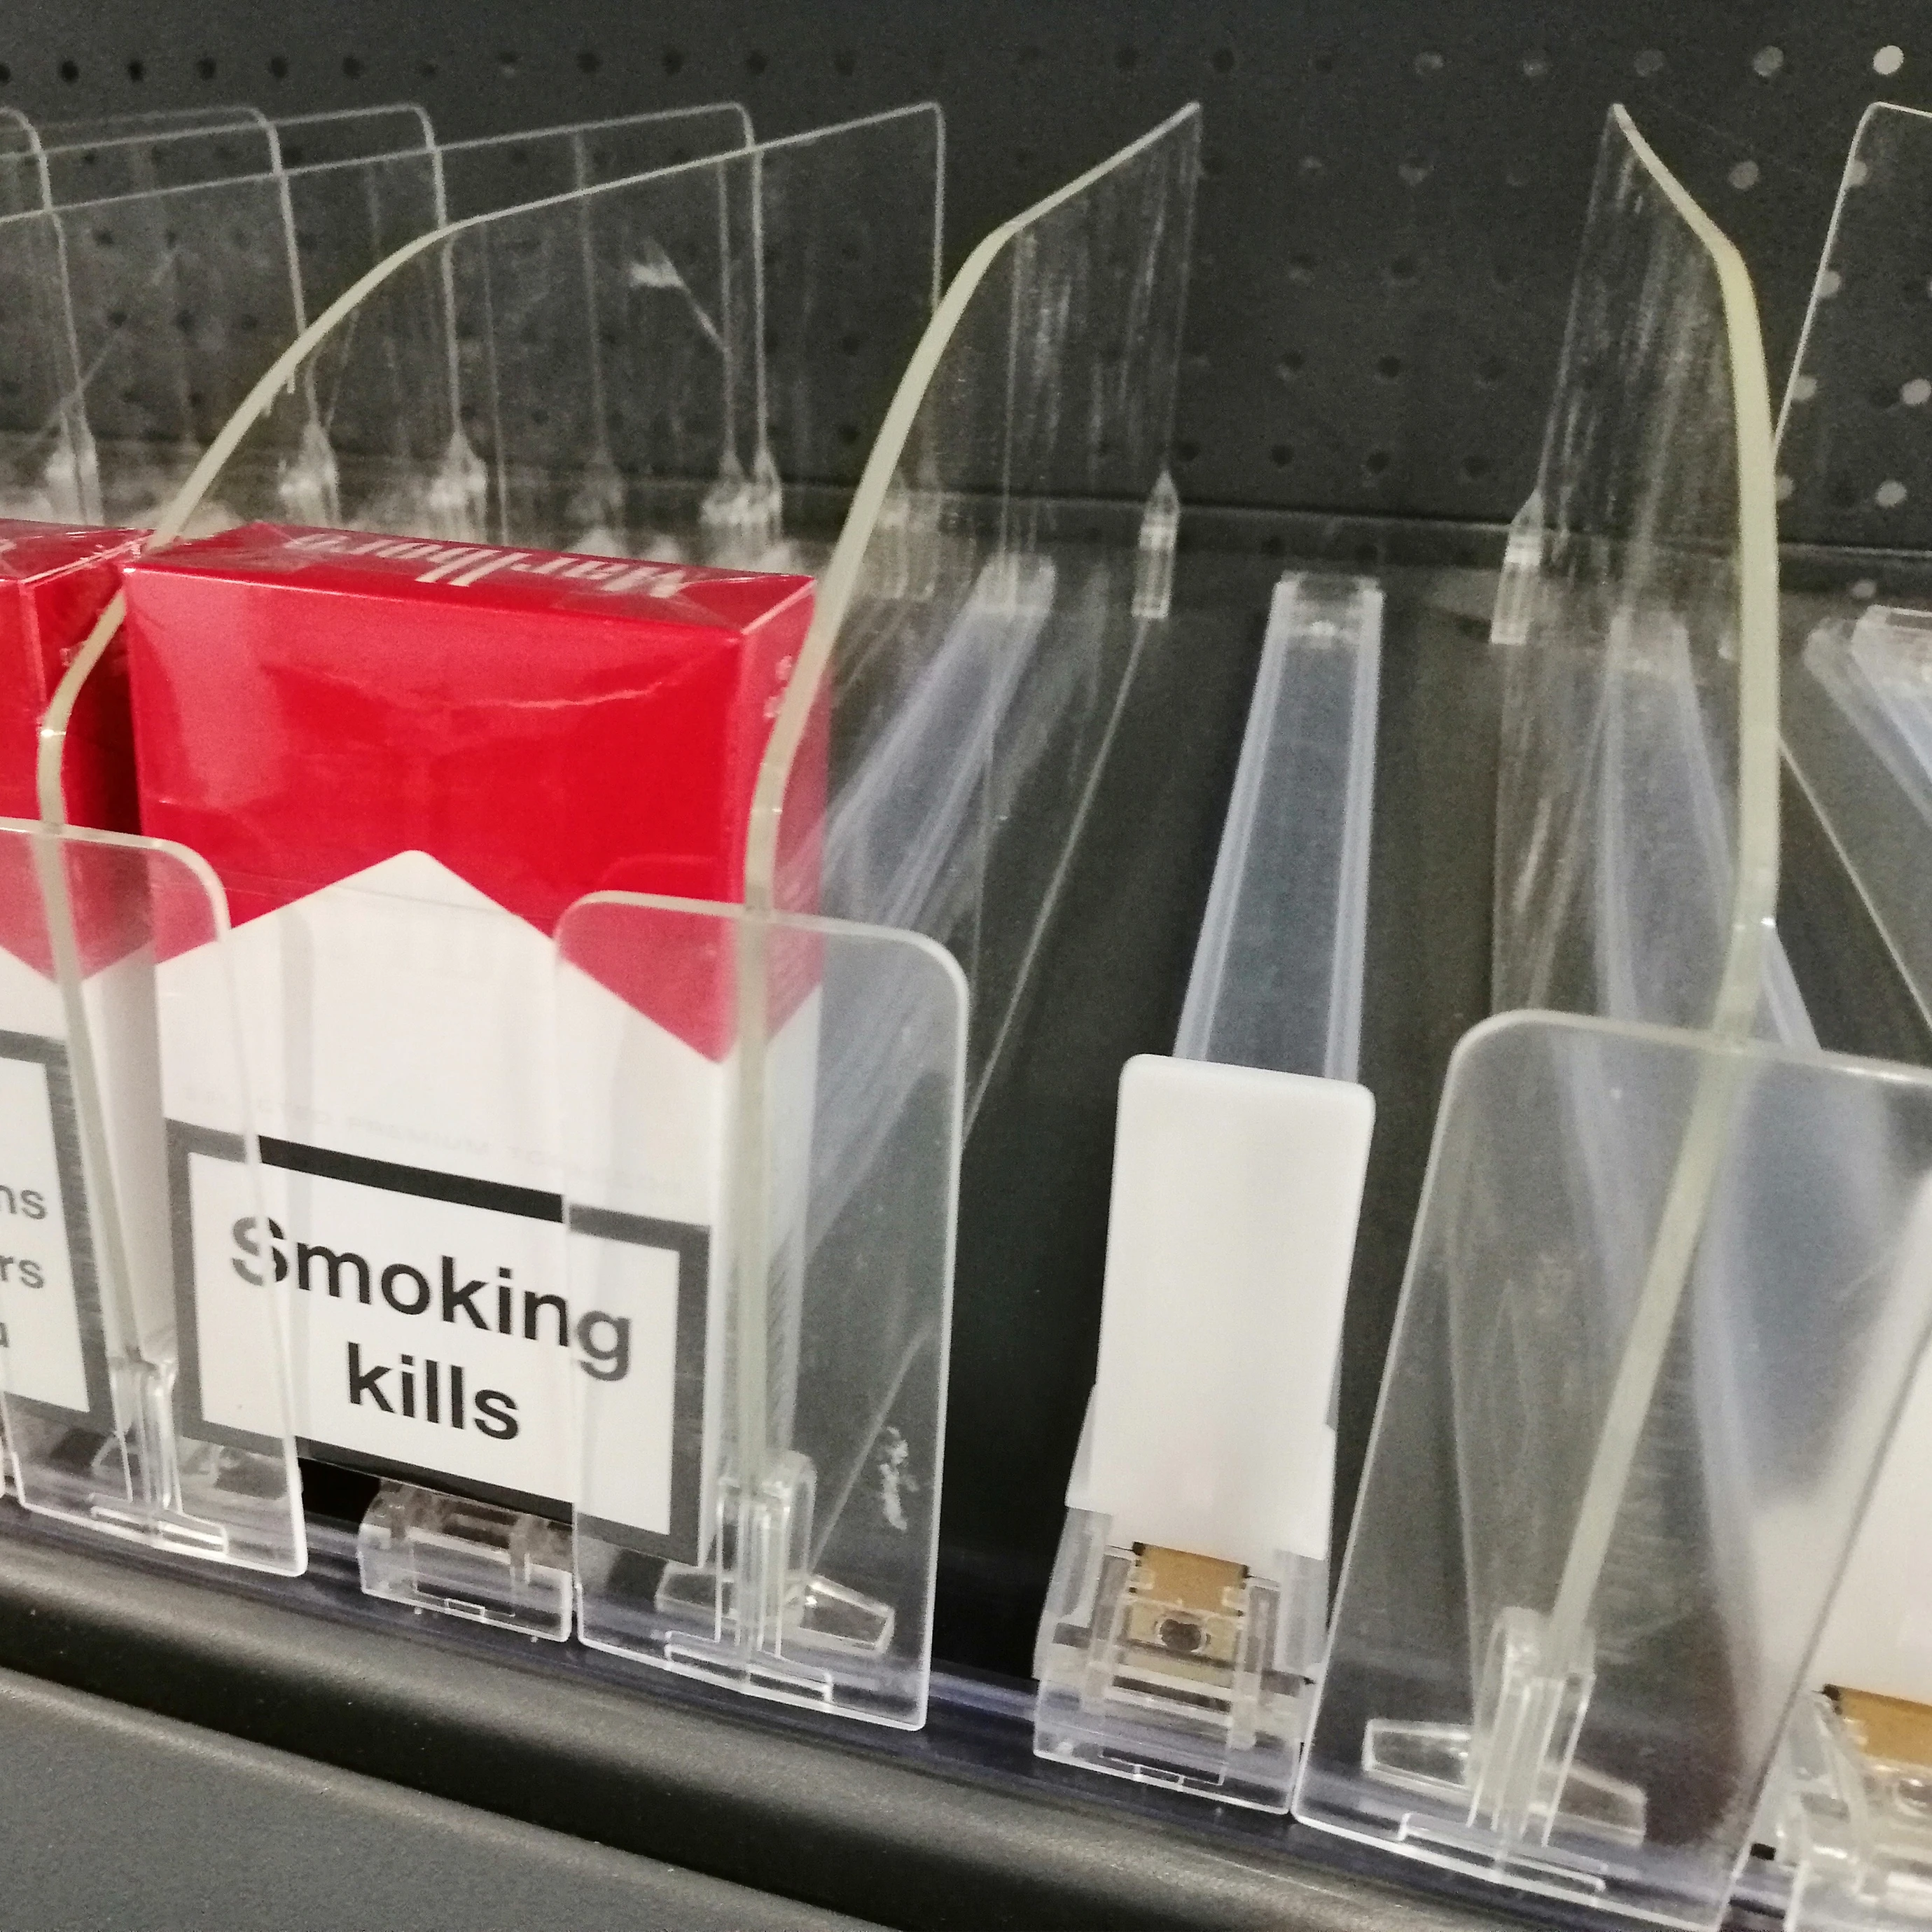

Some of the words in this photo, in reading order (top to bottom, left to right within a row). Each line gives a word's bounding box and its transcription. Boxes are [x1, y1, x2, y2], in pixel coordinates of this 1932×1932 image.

[282, 533, 686, 599] Marlboro
[231, 1216, 632, 1382] Smoking
[347, 1341, 520, 1441] kills
